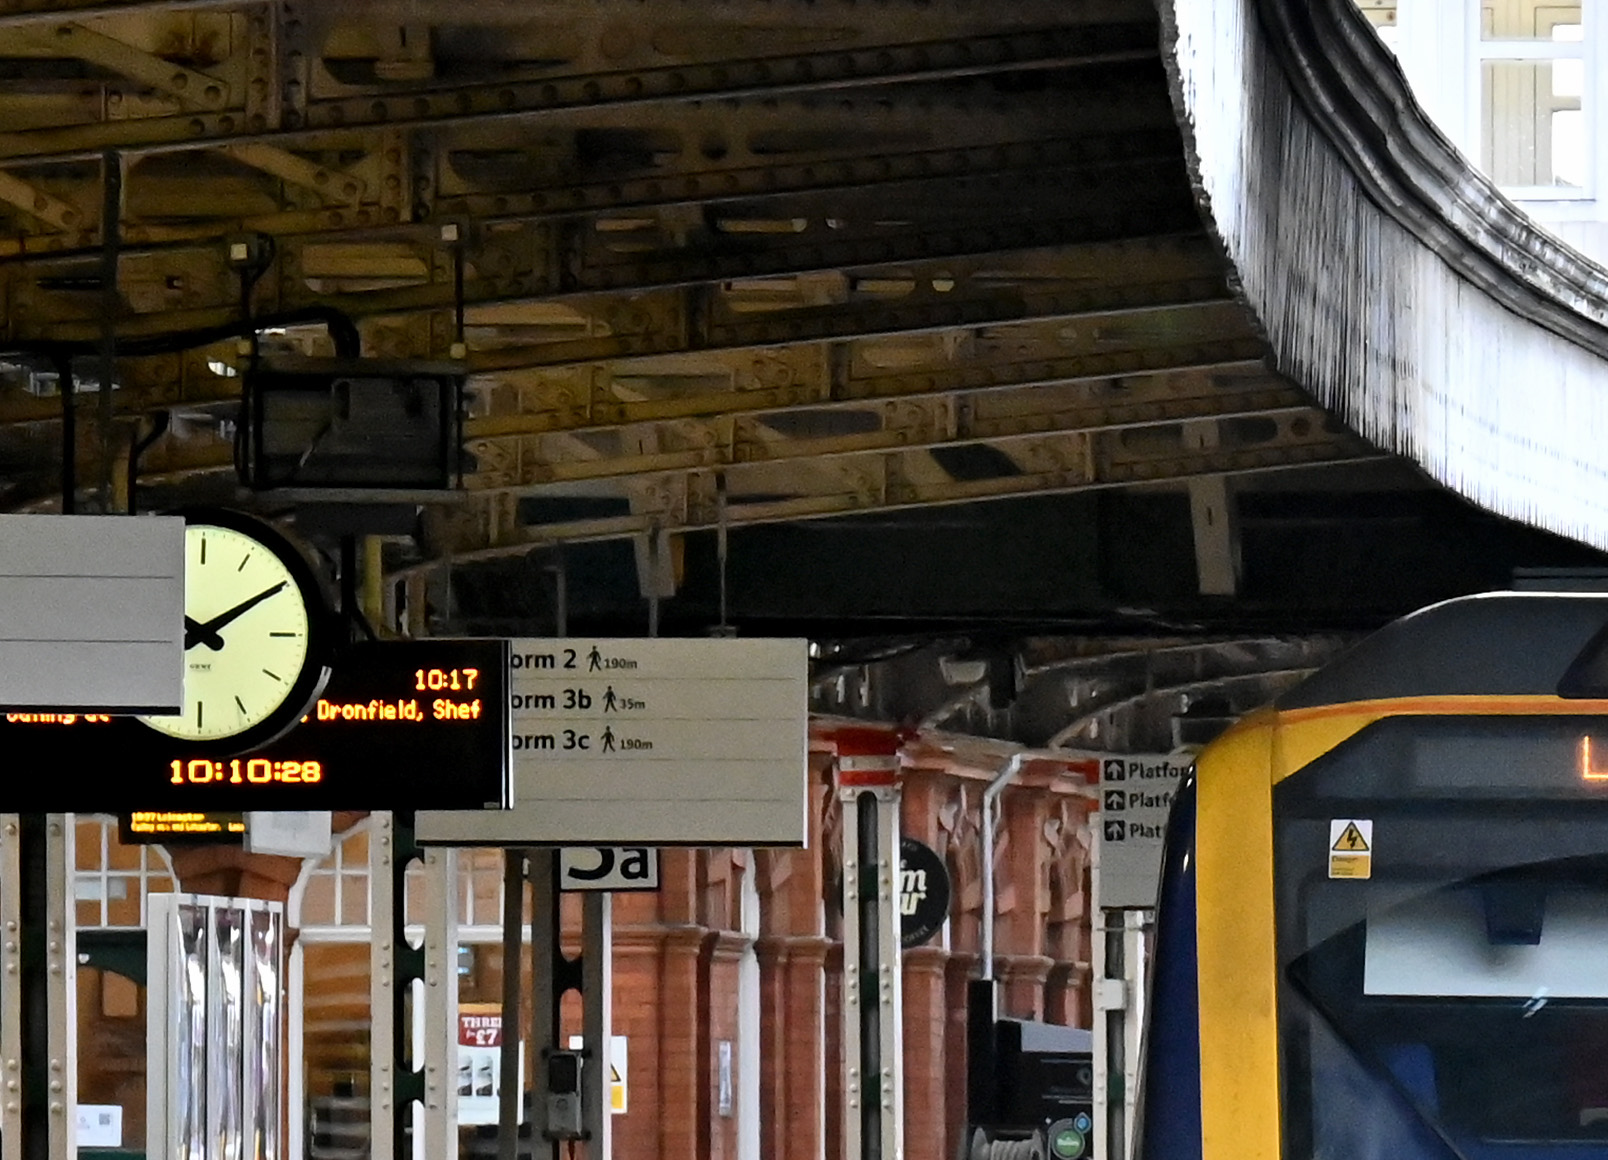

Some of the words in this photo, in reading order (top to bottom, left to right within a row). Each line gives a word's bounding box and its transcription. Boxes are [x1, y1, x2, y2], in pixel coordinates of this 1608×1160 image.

[562, 648, 577, 669] 2
[415, 668, 479, 691] 10:17
[562, 688, 592, 709] 3b
[316, 699, 426, 722] Dronfield,
[432, 698, 481, 720] Shef
[562, 729, 590, 750] 3c
[170, 759, 321, 784] 10:10:28
[1129, 823, 1161, 838] Plat
